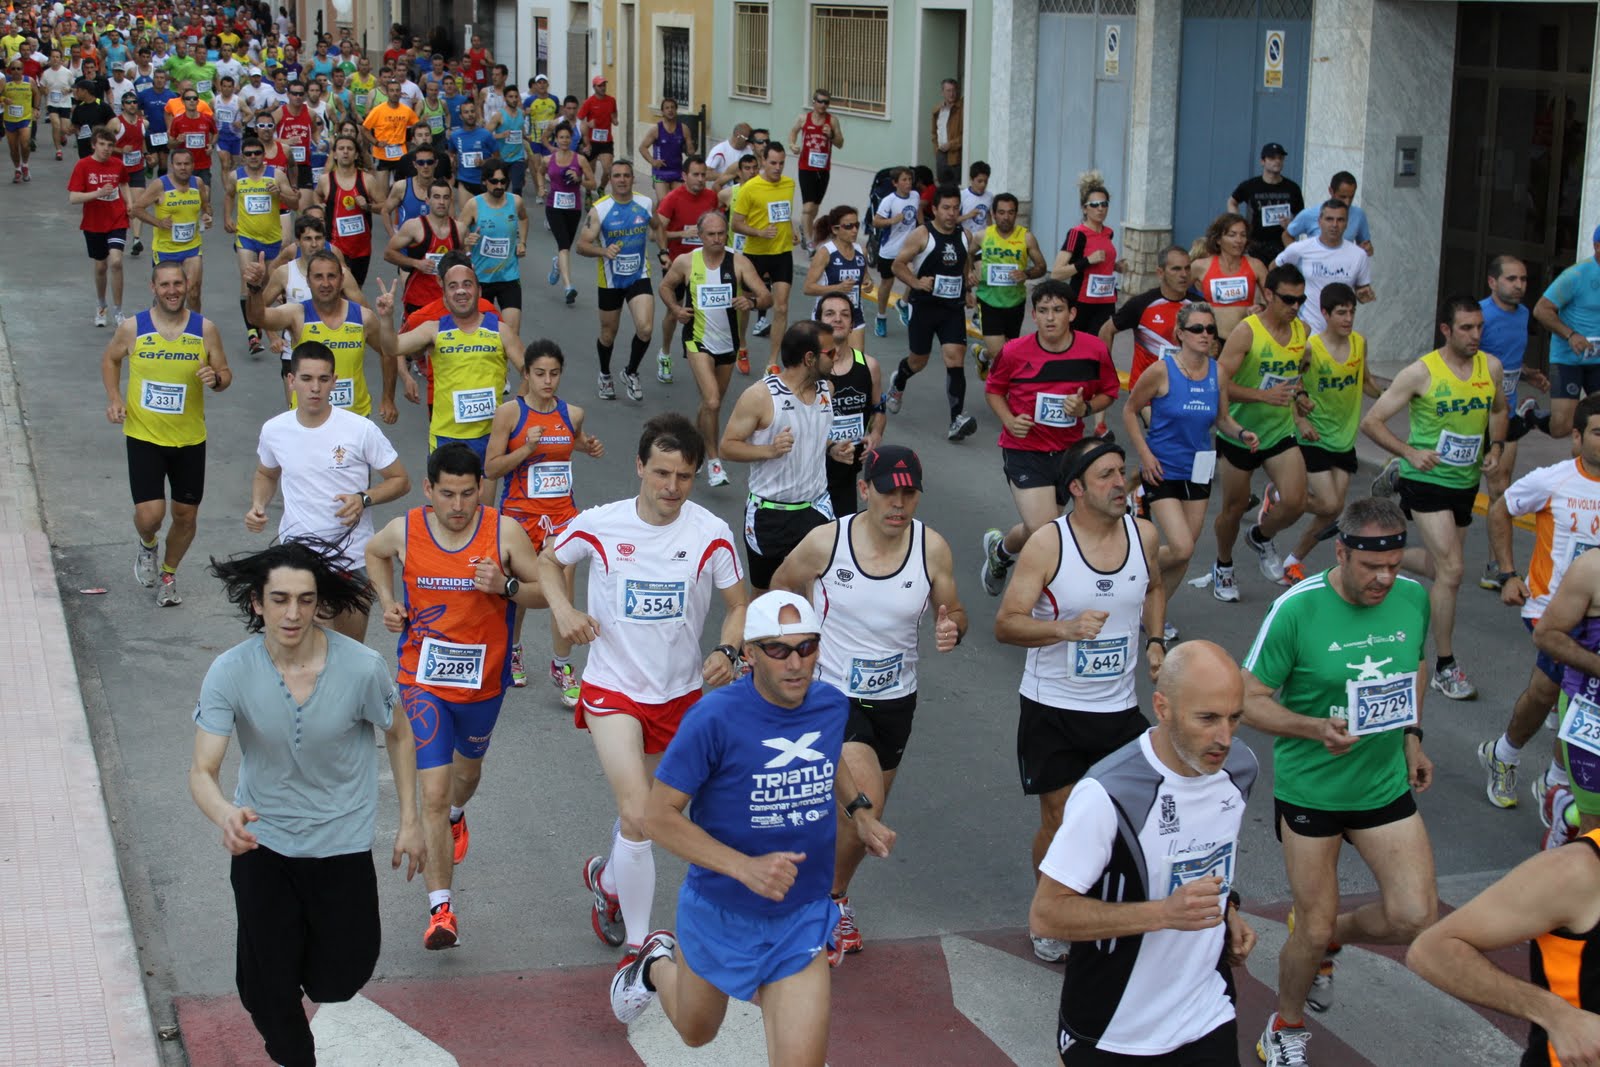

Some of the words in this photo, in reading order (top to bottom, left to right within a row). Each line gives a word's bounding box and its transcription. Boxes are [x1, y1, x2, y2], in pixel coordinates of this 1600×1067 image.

[710, 295, 726, 303] 964
[322, 339, 363, 350] femax
[439, 343, 498, 355] cafemax
[138, 350, 201, 362] cafemax
[156, 396, 175, 406] 331
[467, 401, 491, 415] 2504
[834, 427, 859, 441] 2459
[1453, 448, 1472, 458] 428
[543, 476, 567, 489] 2234
[416, 576, 476, 587] NUTRIDEN
[626, 596, 635, 608] A
[642, 597, 674, 613] 554
[427, 659, 434, 670] S
[1077, 656, 1085, 667] A
[1092, 653, 1120, 671] 642
[436, 662, 475, 675] 2289
[852, 674, 860, 683] A
[866, 670, 894, 688] 668
[1329, 704, 1349, 720] CAS
[1369, 694, 1408, 719] 2729
[1583, 722, 1600, 741] 23
